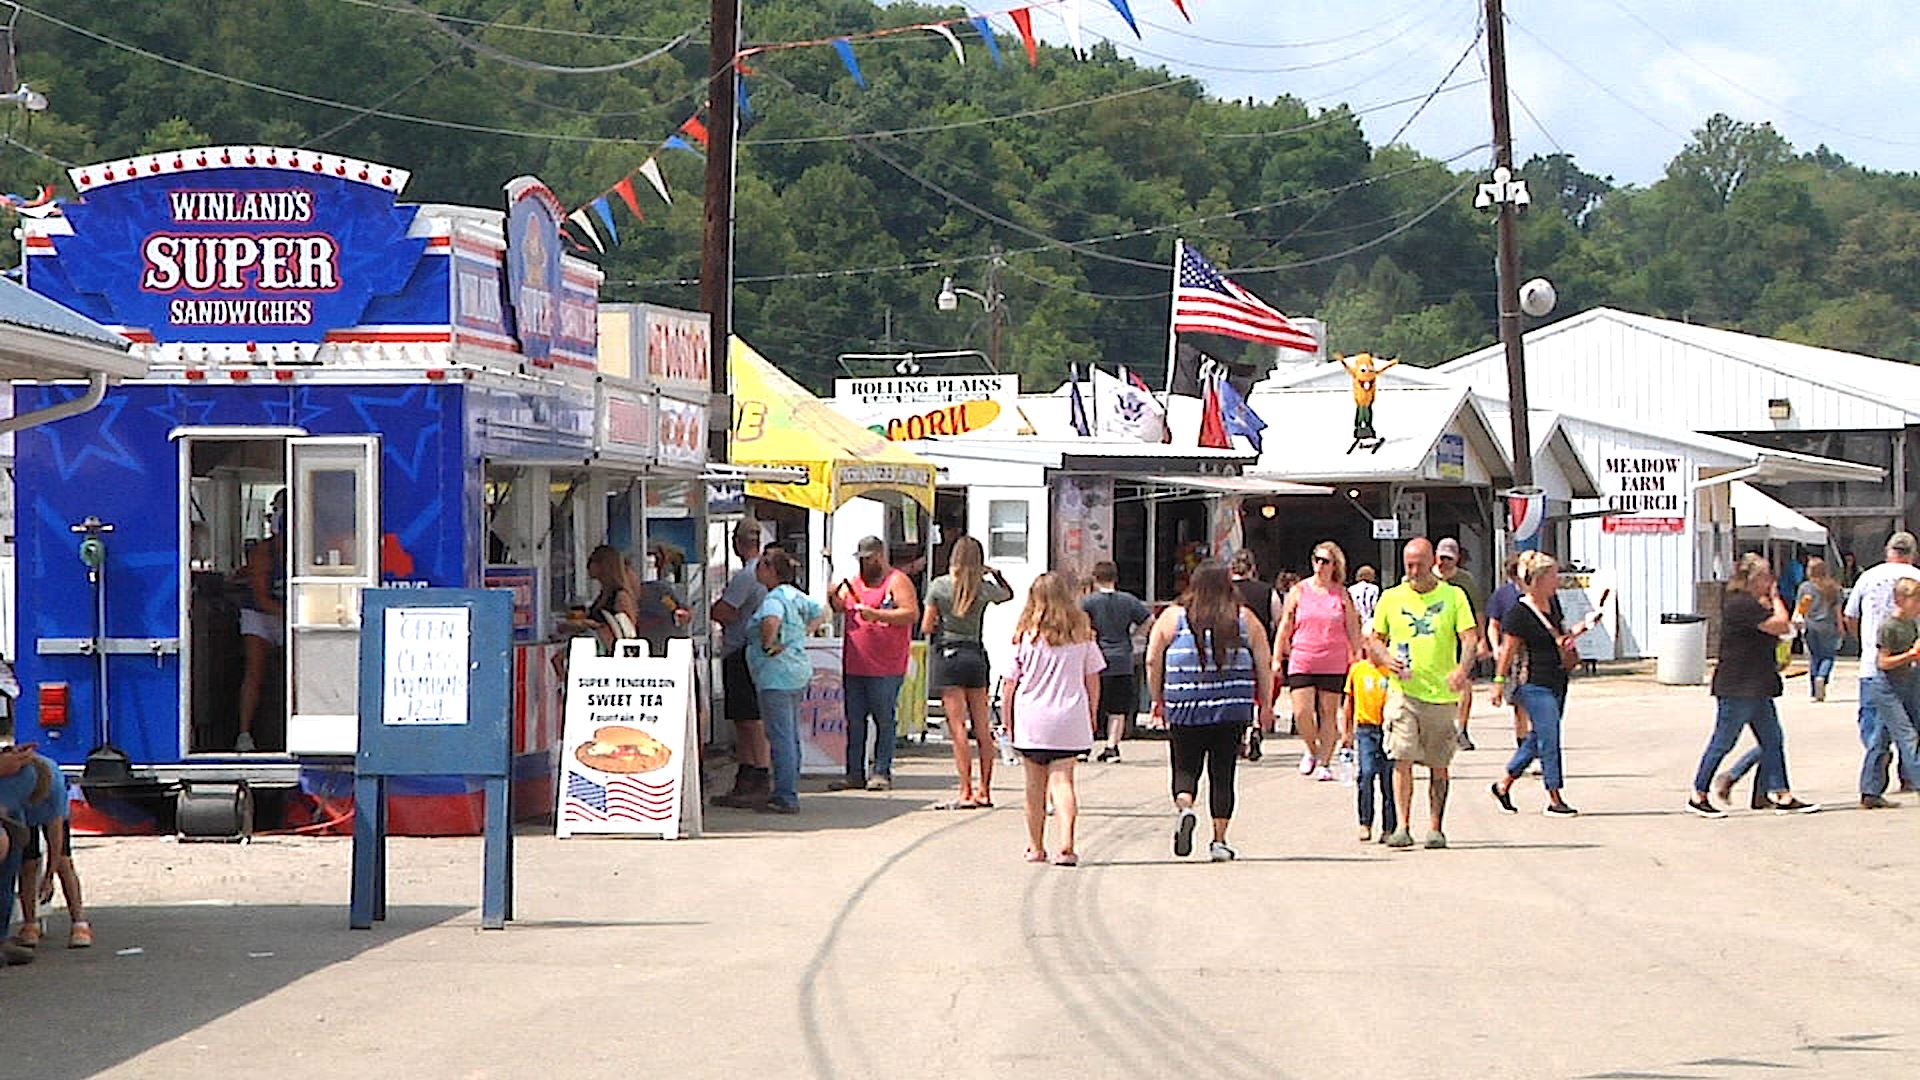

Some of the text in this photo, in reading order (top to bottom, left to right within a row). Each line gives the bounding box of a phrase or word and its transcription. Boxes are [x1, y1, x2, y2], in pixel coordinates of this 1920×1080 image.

[170, 190, 311, 222] WINLAND'S
[144, 235, 338, 291] SUPER
[169, 298, 313, 326] SANDWICHES
[851, 378, 1002, 396] ROLLING PLAINS
[886, 403, 970, 442] CORN
[1605, 457, 1681, 474] MEADOW
[1621, 475, 1665, 492] FARM
[1608, 494, 1678, 511] CHURCH
[587, 694, 663, 707] SWEET TEA
[589, 712, 634, 722] Fountain
